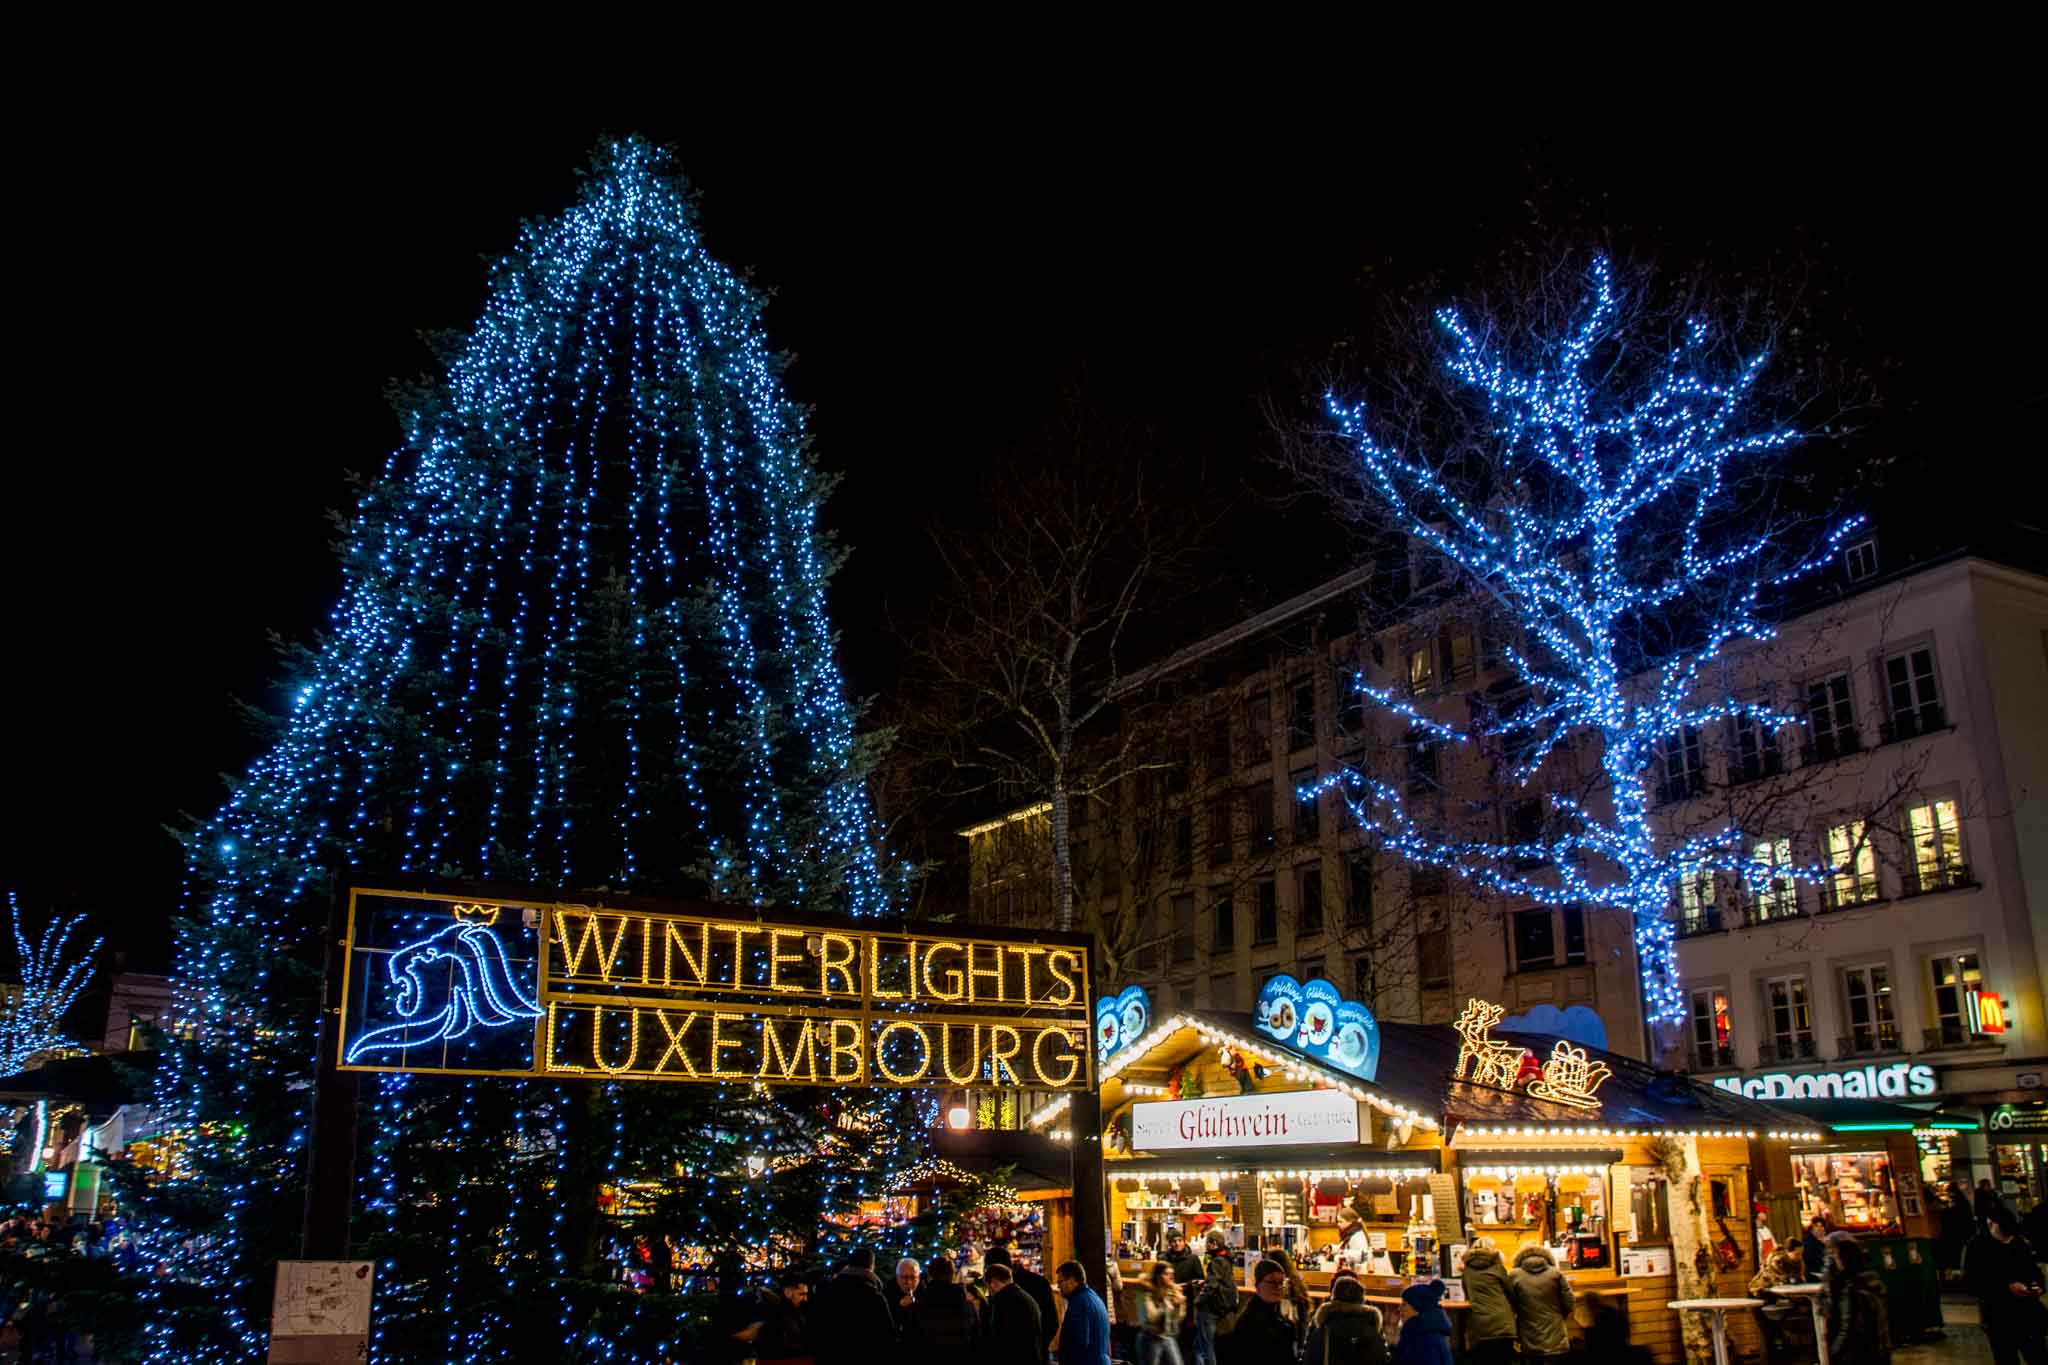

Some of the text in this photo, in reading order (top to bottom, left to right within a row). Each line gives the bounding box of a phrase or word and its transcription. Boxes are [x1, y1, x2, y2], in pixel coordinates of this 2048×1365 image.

[545, 1002, 1079, 1087] LUXEMBOURG
[1714, 1063, 1936, 1100] McDonald's
[1179, 1104, 1288, 1141] Glühwein
